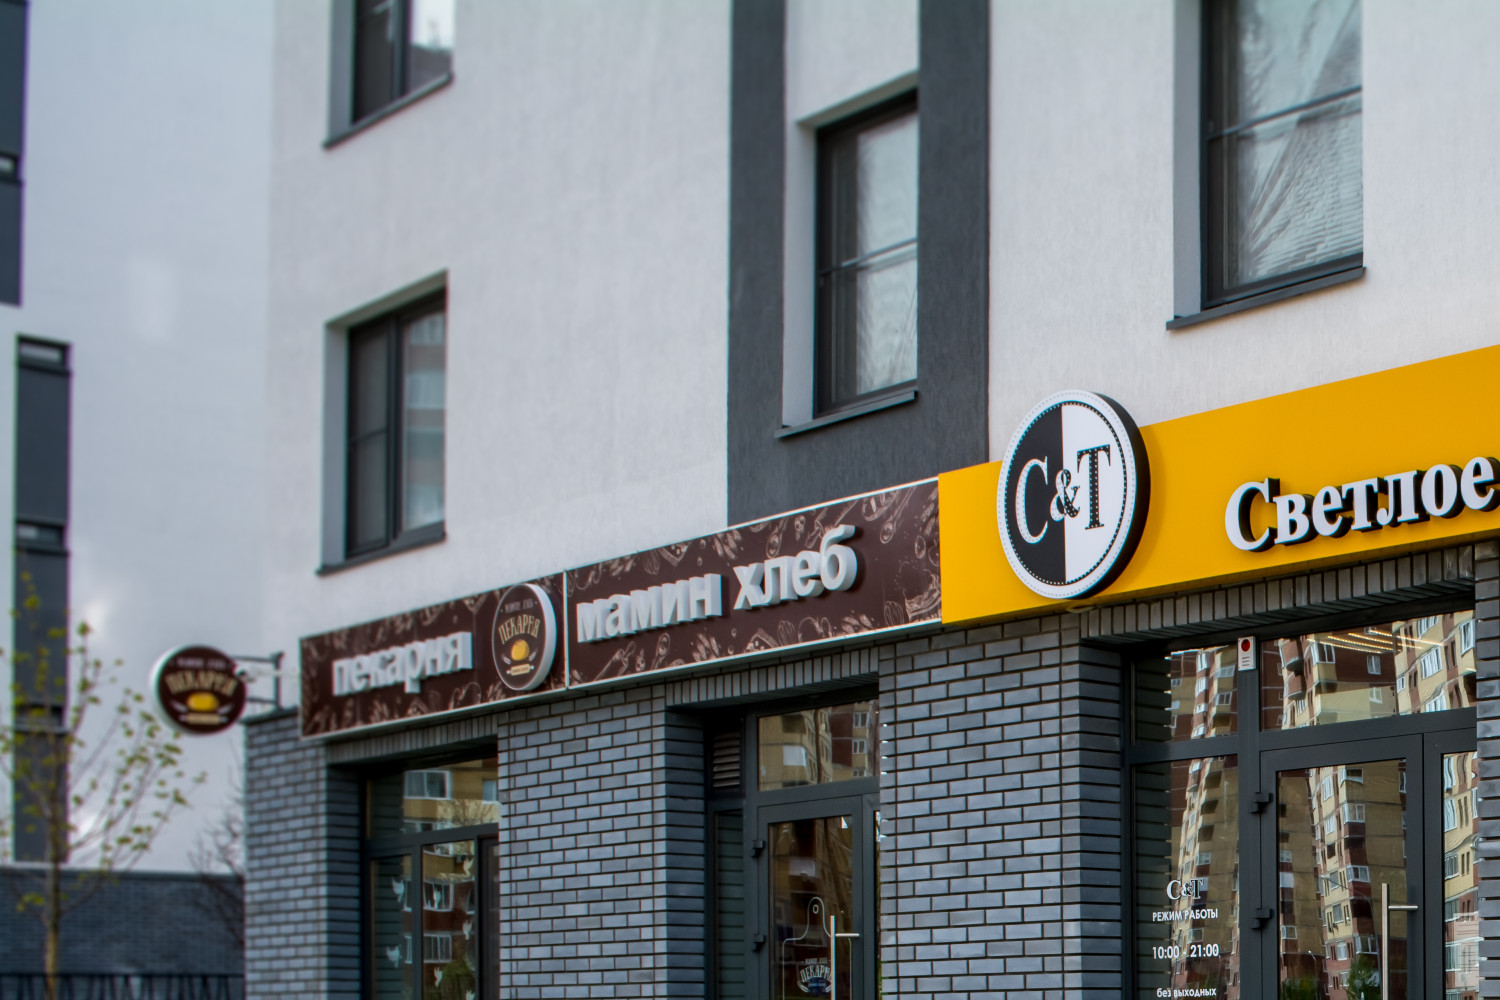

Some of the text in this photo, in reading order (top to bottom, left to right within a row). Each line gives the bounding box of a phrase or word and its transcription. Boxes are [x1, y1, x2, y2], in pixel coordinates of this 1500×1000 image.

[576, 524, 857, 643] мамин хлеб
[332, 631, 473, 696] пекарня
[1152, 908, 1219, 922] РЕЖИМ РАБОТЫ
[1152, 945, 1180, 959] 10:00
[1190, 943, 1220, 958] 21:00
[800, 964, 832, 983] ПЕКАРН
[1156, 987, 1217, 998] без выходных
